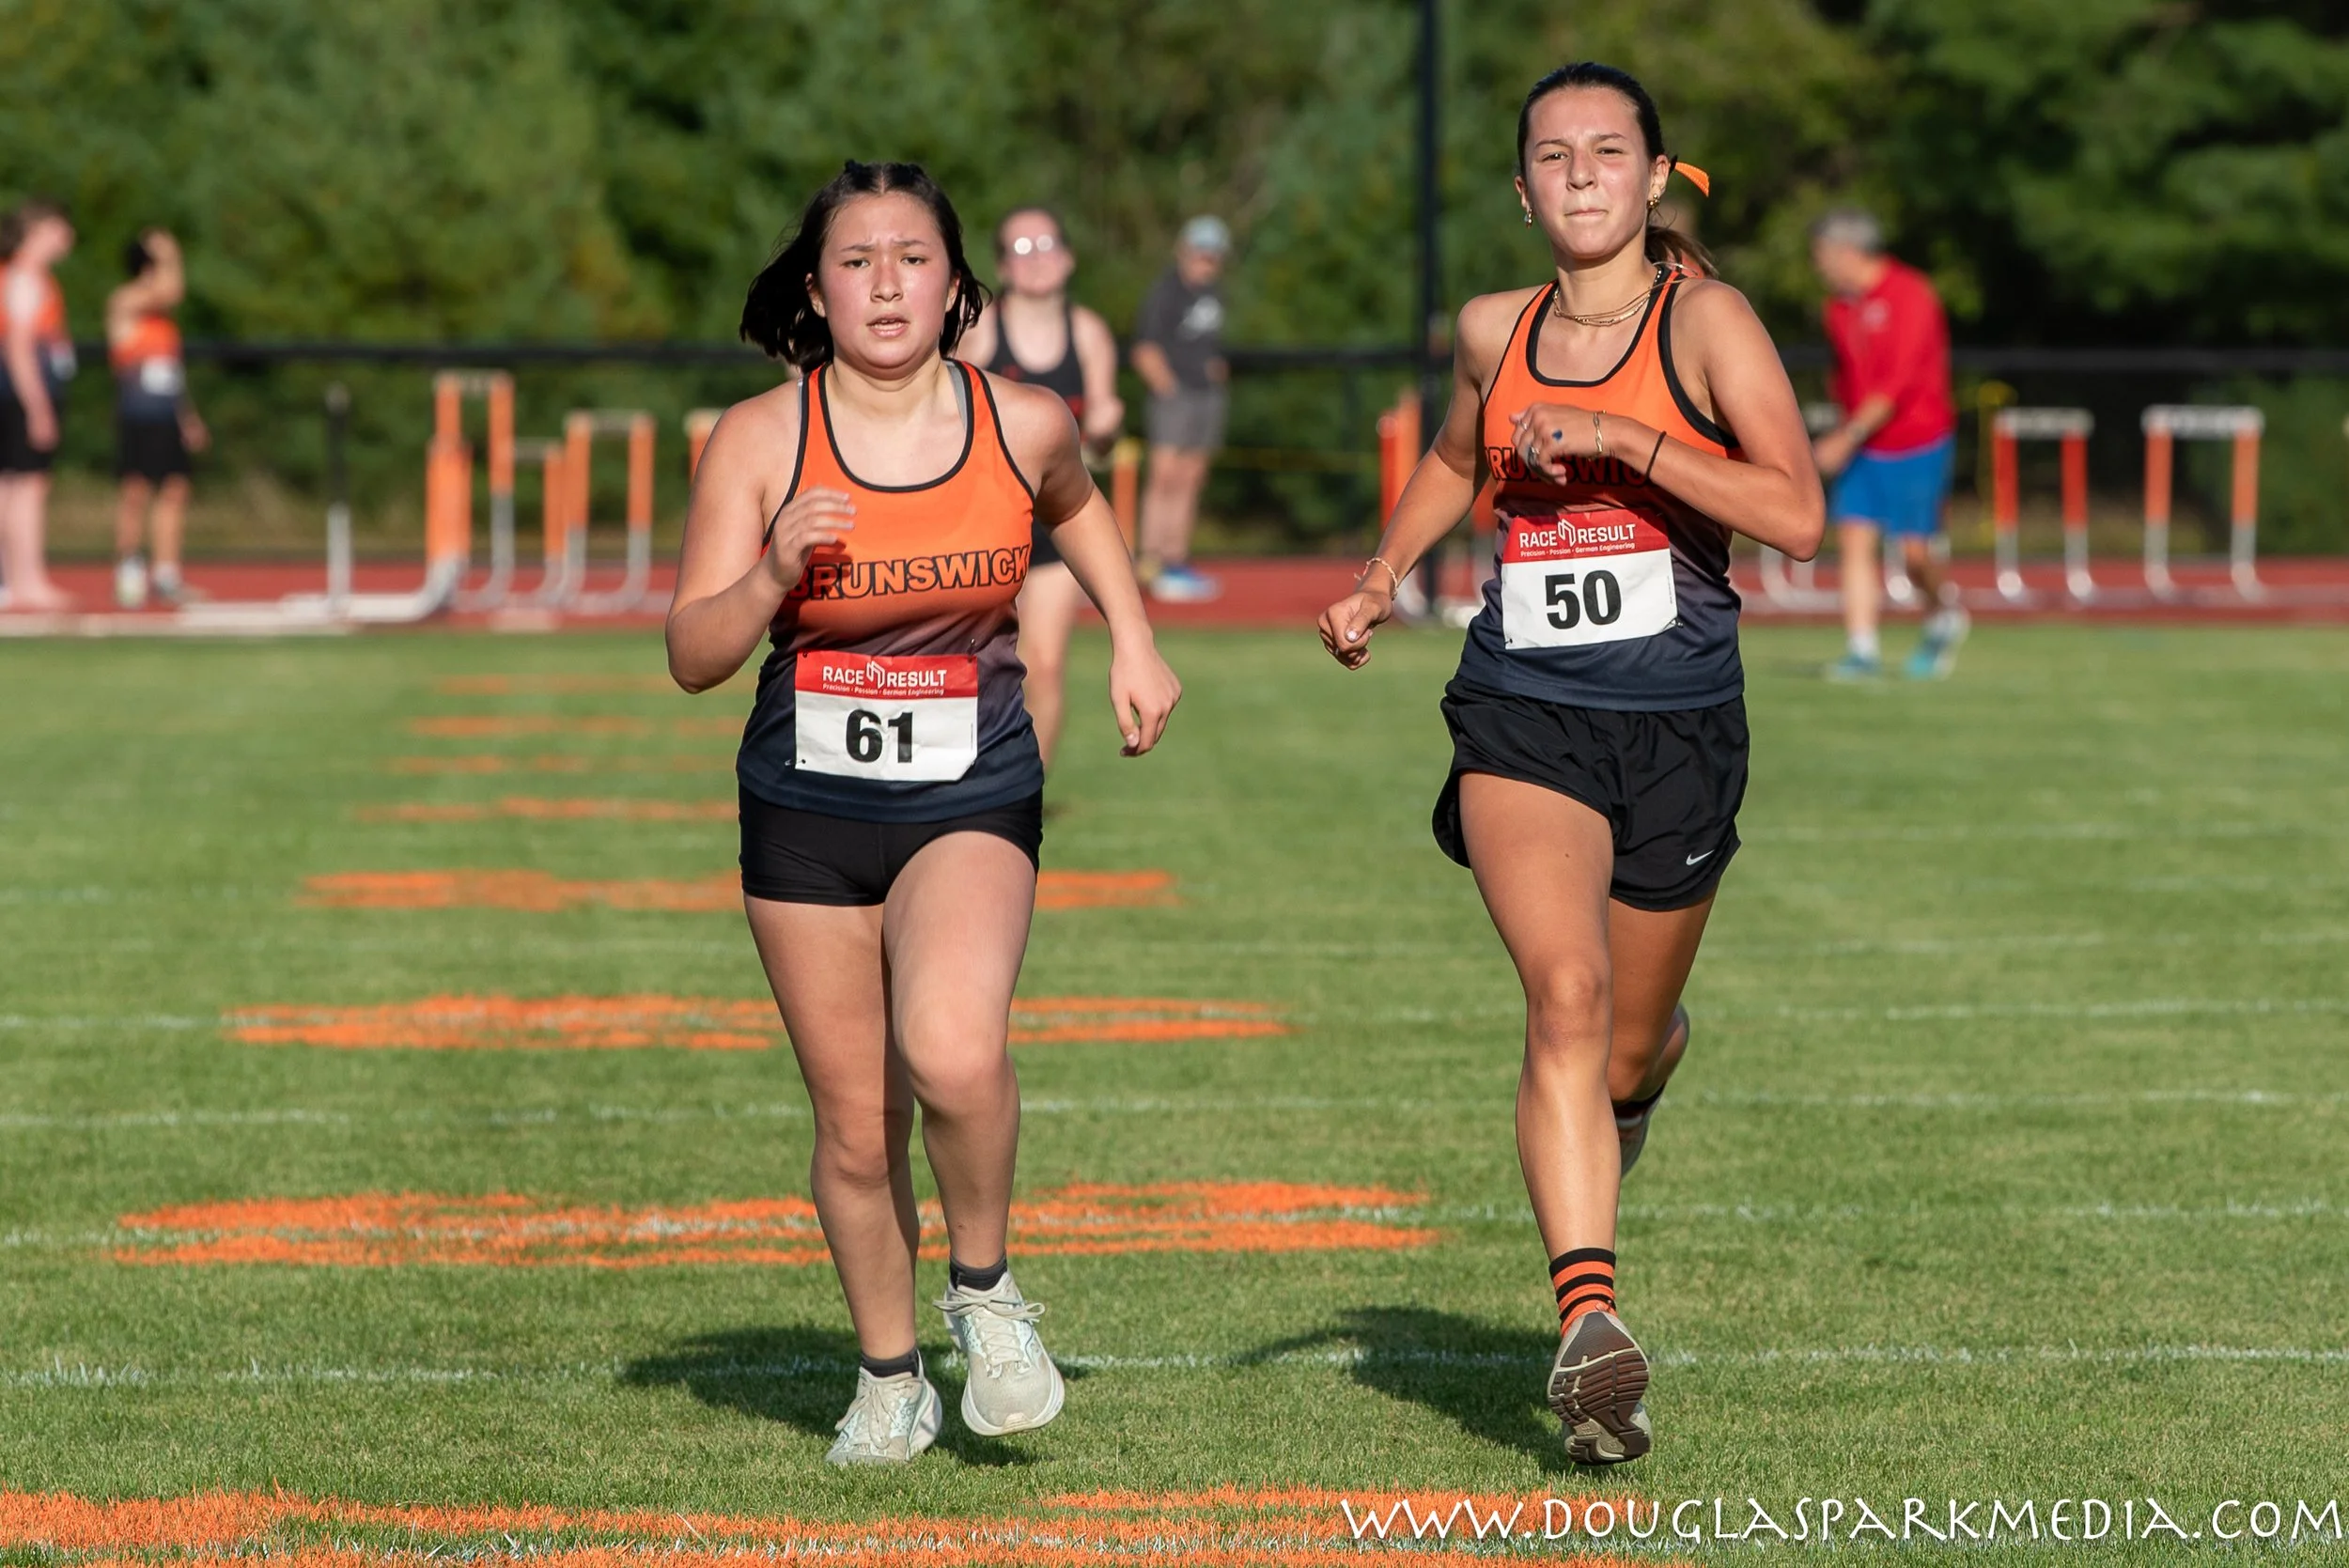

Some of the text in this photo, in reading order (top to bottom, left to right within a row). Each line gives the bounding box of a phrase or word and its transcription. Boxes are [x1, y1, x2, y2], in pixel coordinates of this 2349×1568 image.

[1518, 523, 1636, 548] RACE RESULT
[1520, 549, 1546, 557] Precision
[1599, 542, 1636, 552] Engineering
[1545, 569, 1622, 629] 50
[822, 665, 948, 688] RACE RESULT
[822, 683, 944, 697] Precision Passion German Engineering
[846, 709, 913, 764] 61
